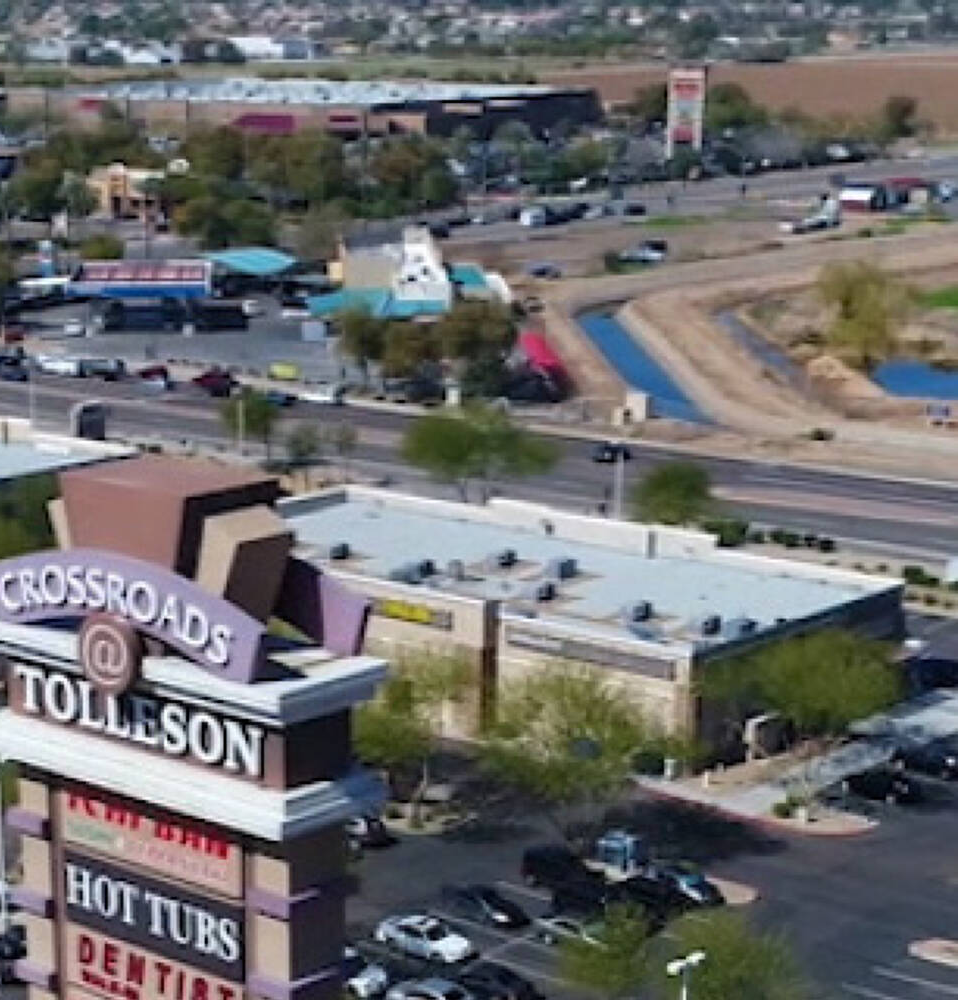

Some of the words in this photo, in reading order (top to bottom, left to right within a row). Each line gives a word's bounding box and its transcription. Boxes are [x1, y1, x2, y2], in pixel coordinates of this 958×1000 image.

[0, 564, 232, 666] CROSSROADS
[14, 664, 265, 777] TOLLESON
[66, 863, 138, 926] HOT
[145, 890, 239, 962] TUBS
